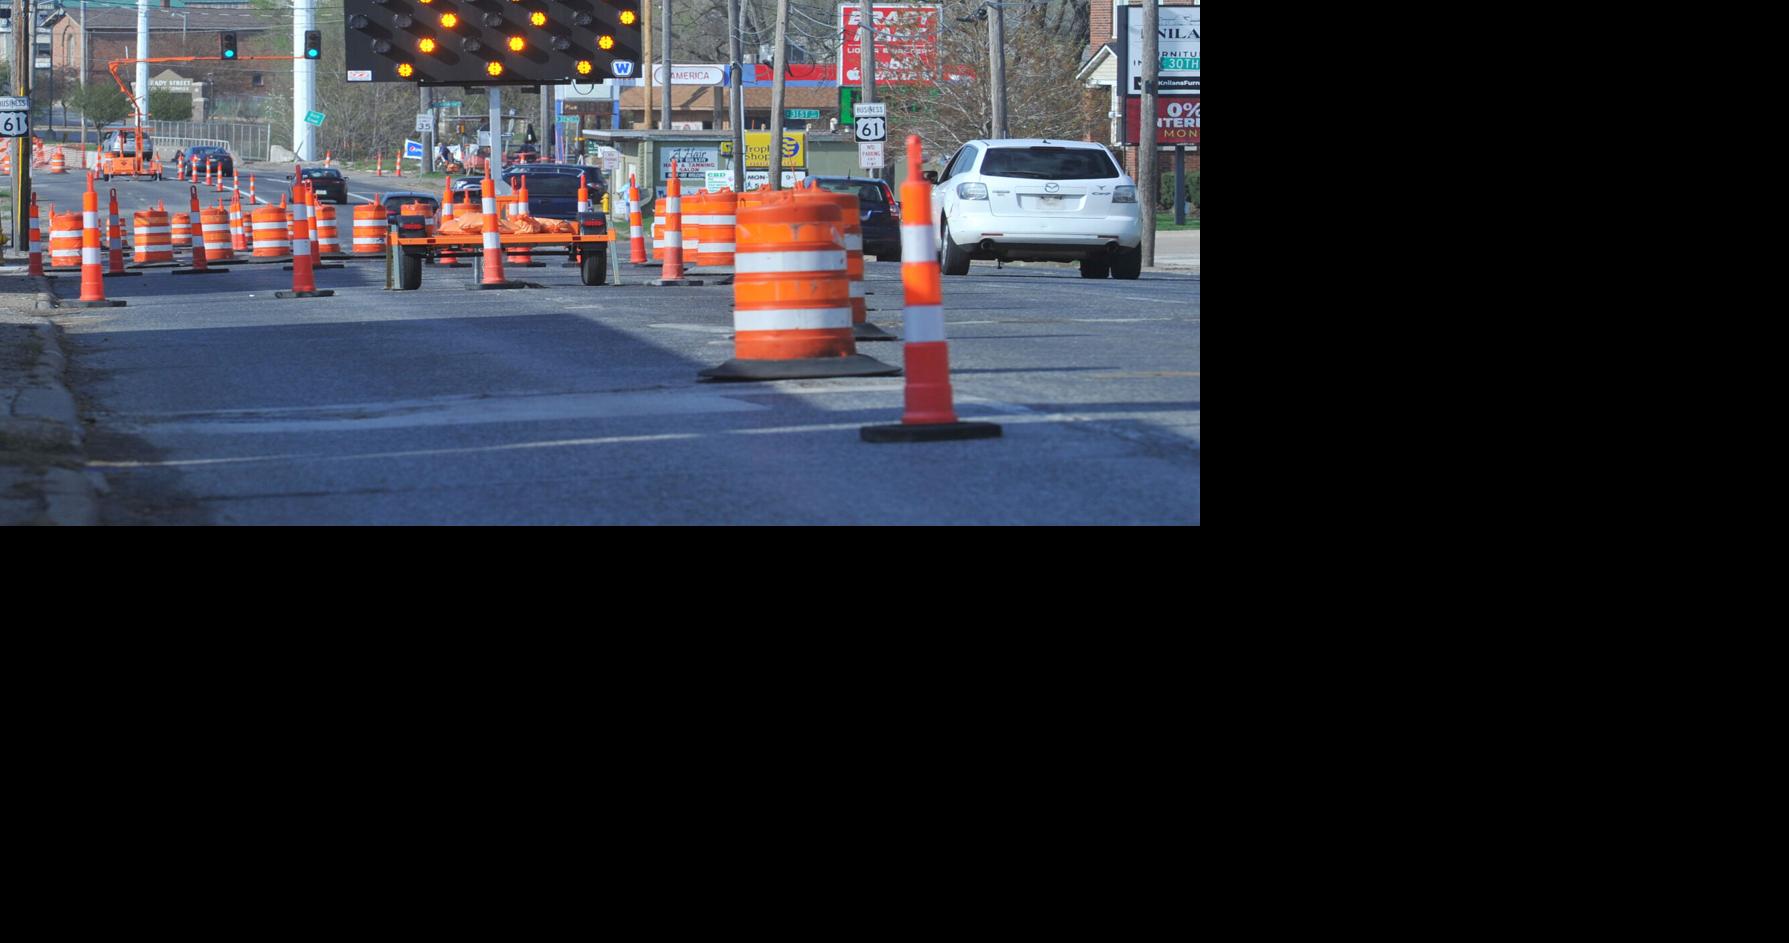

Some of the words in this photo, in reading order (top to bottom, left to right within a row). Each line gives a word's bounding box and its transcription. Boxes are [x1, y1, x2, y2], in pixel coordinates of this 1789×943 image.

[1141, 28, 1200, 39] NILA
[616, 63, 629, 74] W
[1168, 58, 1199, 69] 30TH
[671, 71, 709, 80] AMERICA
[1167, 102, 1200, 118] 0%
[4, 117, 21, 131] 61
[862, 122, 878, 137] 61
